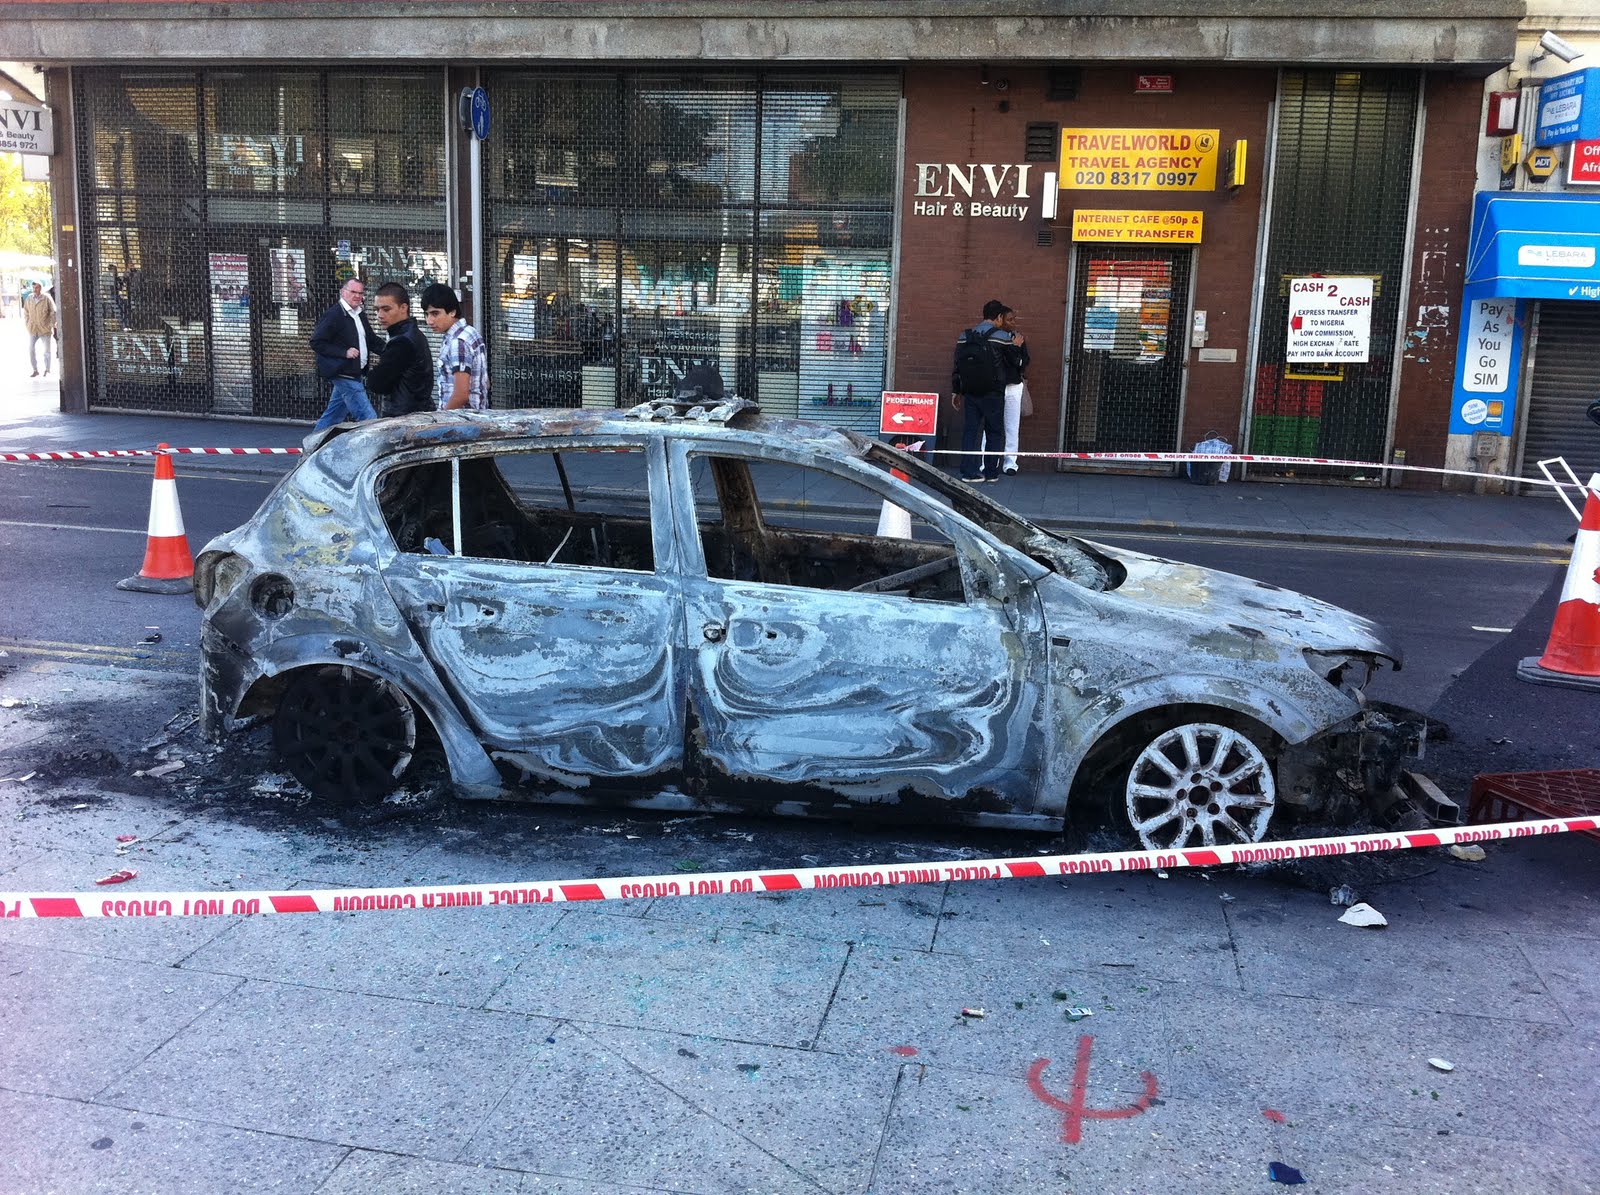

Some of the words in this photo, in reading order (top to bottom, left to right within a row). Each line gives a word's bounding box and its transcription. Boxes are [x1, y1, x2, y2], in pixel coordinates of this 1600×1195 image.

[7, 131, 35, 141] Beauty
[0, 140, 17, 148] 854
[20, 141, 38, 150] 9721
[1067, 135, 1191, 151] TRAVELWORLD
[1069, 157, 1130, 168] TRAVEL
[1135, 157, 1203, 169] AGENCY
[1535, 156, 1551, 166] ADT
[914, 163, 1033, 198] ENVI
[1075, 171, 1105, 185] 020
[1110, 171, 1151, 186] 8317
[1156, 172, 1198, 186] 0997
[913, 201, 947, 216] Hair
[952, 202, 964, 216] &
[970, 202, 1029, 221] Beauty
[1077, 215, 1129, 223] INTERNET
[1132, 215, 1160, 224] CAFE
[1162, 215, 1188, 226] @50p
[1191, 216, 1199, 224] &
[1077, 229, 1123, 237] MONEY
[1127, 229, 1194, 238] TRANSFER
[1293, 283, 1324, 293] CASH
[1327, 285, 1338, 297] 2
[1340, 297, 1370, 306] CASH
[1480, 303, 1504, 318] Pay
[1482, 321, 1499, 333] As
[111, 336, 189, 362] ENVI
[1478, 338, 1501, 350] You
[1479, 356, 1496, 368] Go
[1473, 373, 1498, 386] SIM
[648, 387, 669, 398] Hair
[886, 397, 934, 405] PEDESTRIANS
